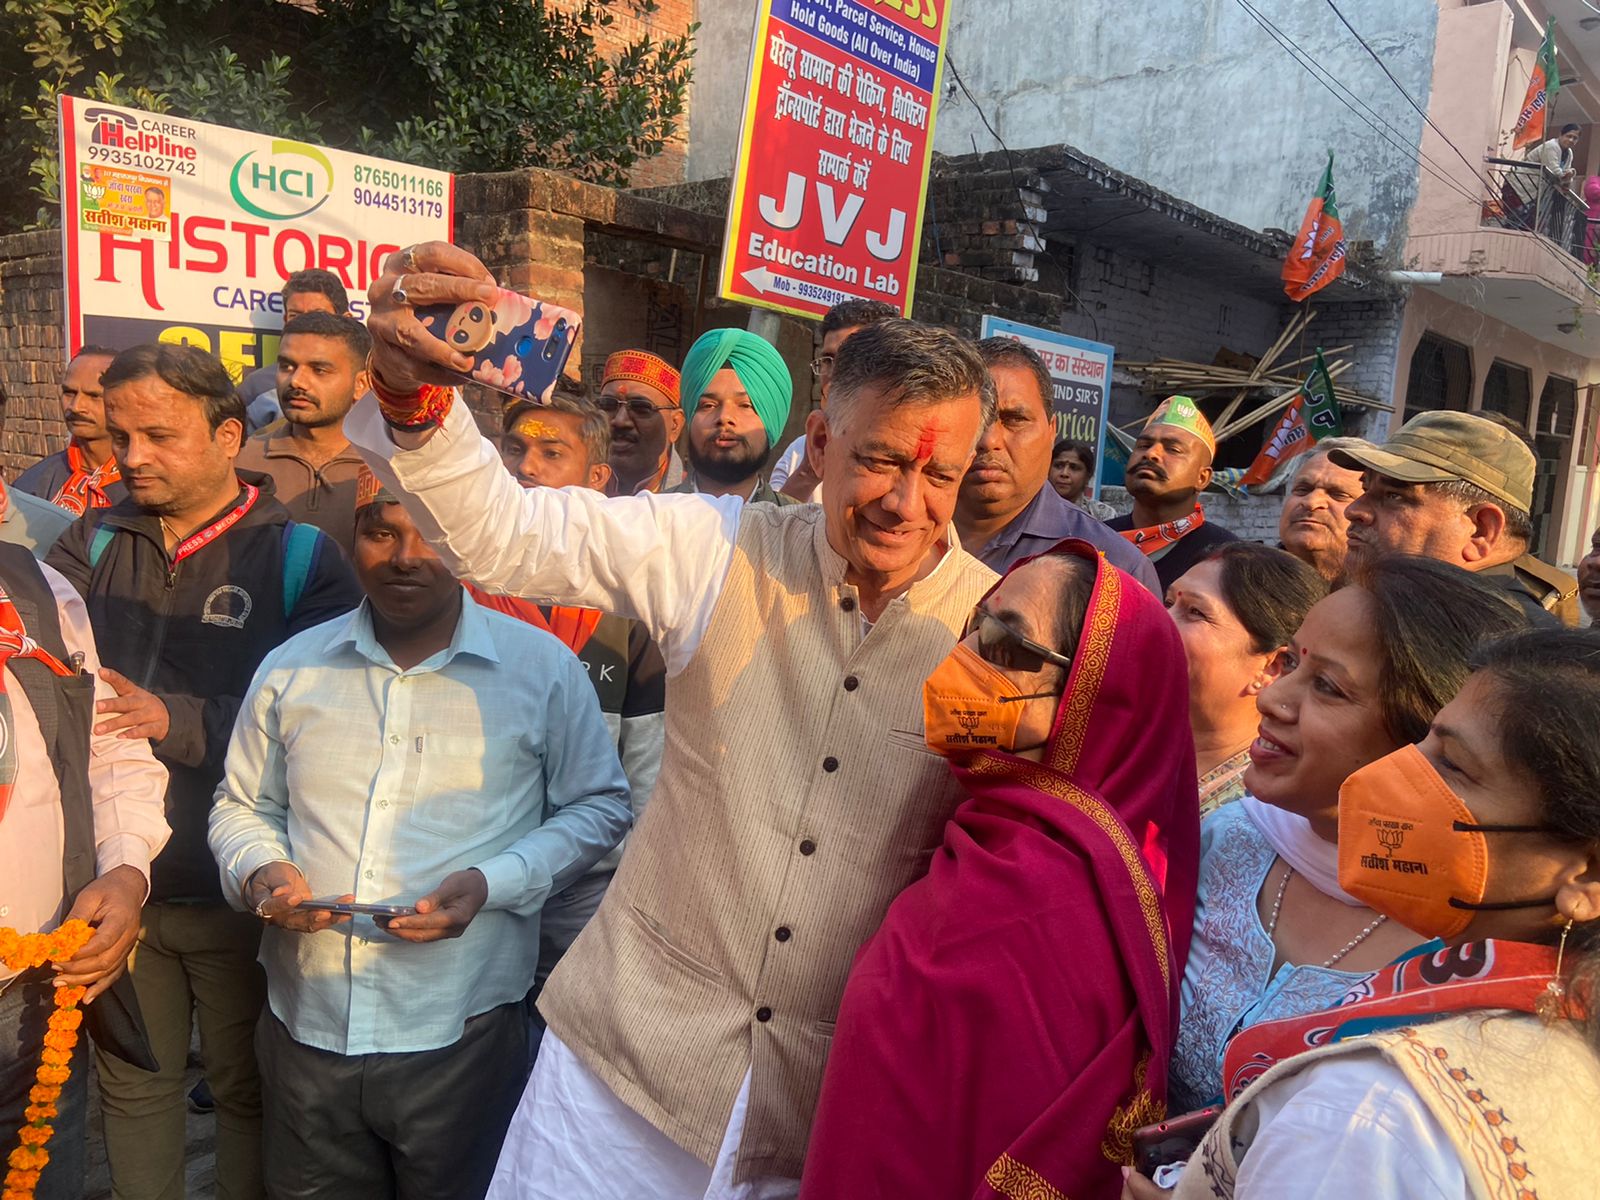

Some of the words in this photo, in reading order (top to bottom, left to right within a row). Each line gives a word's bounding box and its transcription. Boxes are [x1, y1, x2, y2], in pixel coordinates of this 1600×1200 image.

[790, 1, 816, 28] Hold
[818, 15, 849, 45] Goods
[851, 32, 869, 55] (All
[871, 40, 893, 64] Over
[894, 53, 921, 82] India)
[835, 0, 868, 28] Parcel
[869, 15, 906, 51] Service,
[909, 35, 936, 63] House
[769, 30, 798, 80] घरेलू
[800, 48, 835, 90] सामान
[837, 63, 854, 98] की
[101, 118, 197, 160] Helpline
[141, 119, 197, 140] CAREER
[823, 106, 846, 139] द्वारा
[848, 110, 876, 151] भेजने
[877, 124, 890, 155] के
[890, 129, 912, 165] लिए
[88, 145, 197, 177] 9935102742
[818, 149, 852, 183] सम्पर्क
[251, 161, 314, 198] HCI
[353, 164, 443, 198] 8765011166
[353, 187, 443, 219] 9044513179
[84, 209, 125, 227] सतीश
[127, 215, 168, 233] महाना
[748, 232, 858, 285] Education
[864, 267, 900, 296] Lab
[213, 286, 283, 314] CARE
[773, 276, 791, 292] Mob
[1055, 353, 1070, 373] का
[1071, 352, 1105, 379] संस्थान
[1053, 384, 1074, 400] IND
[1075, 388, 1099, 405] SIR'S
[177, 535, 204, 556] PRESS
[1361, 853, 1389, 871] सतीश
[1392, 859, 1428, 875] महाना
